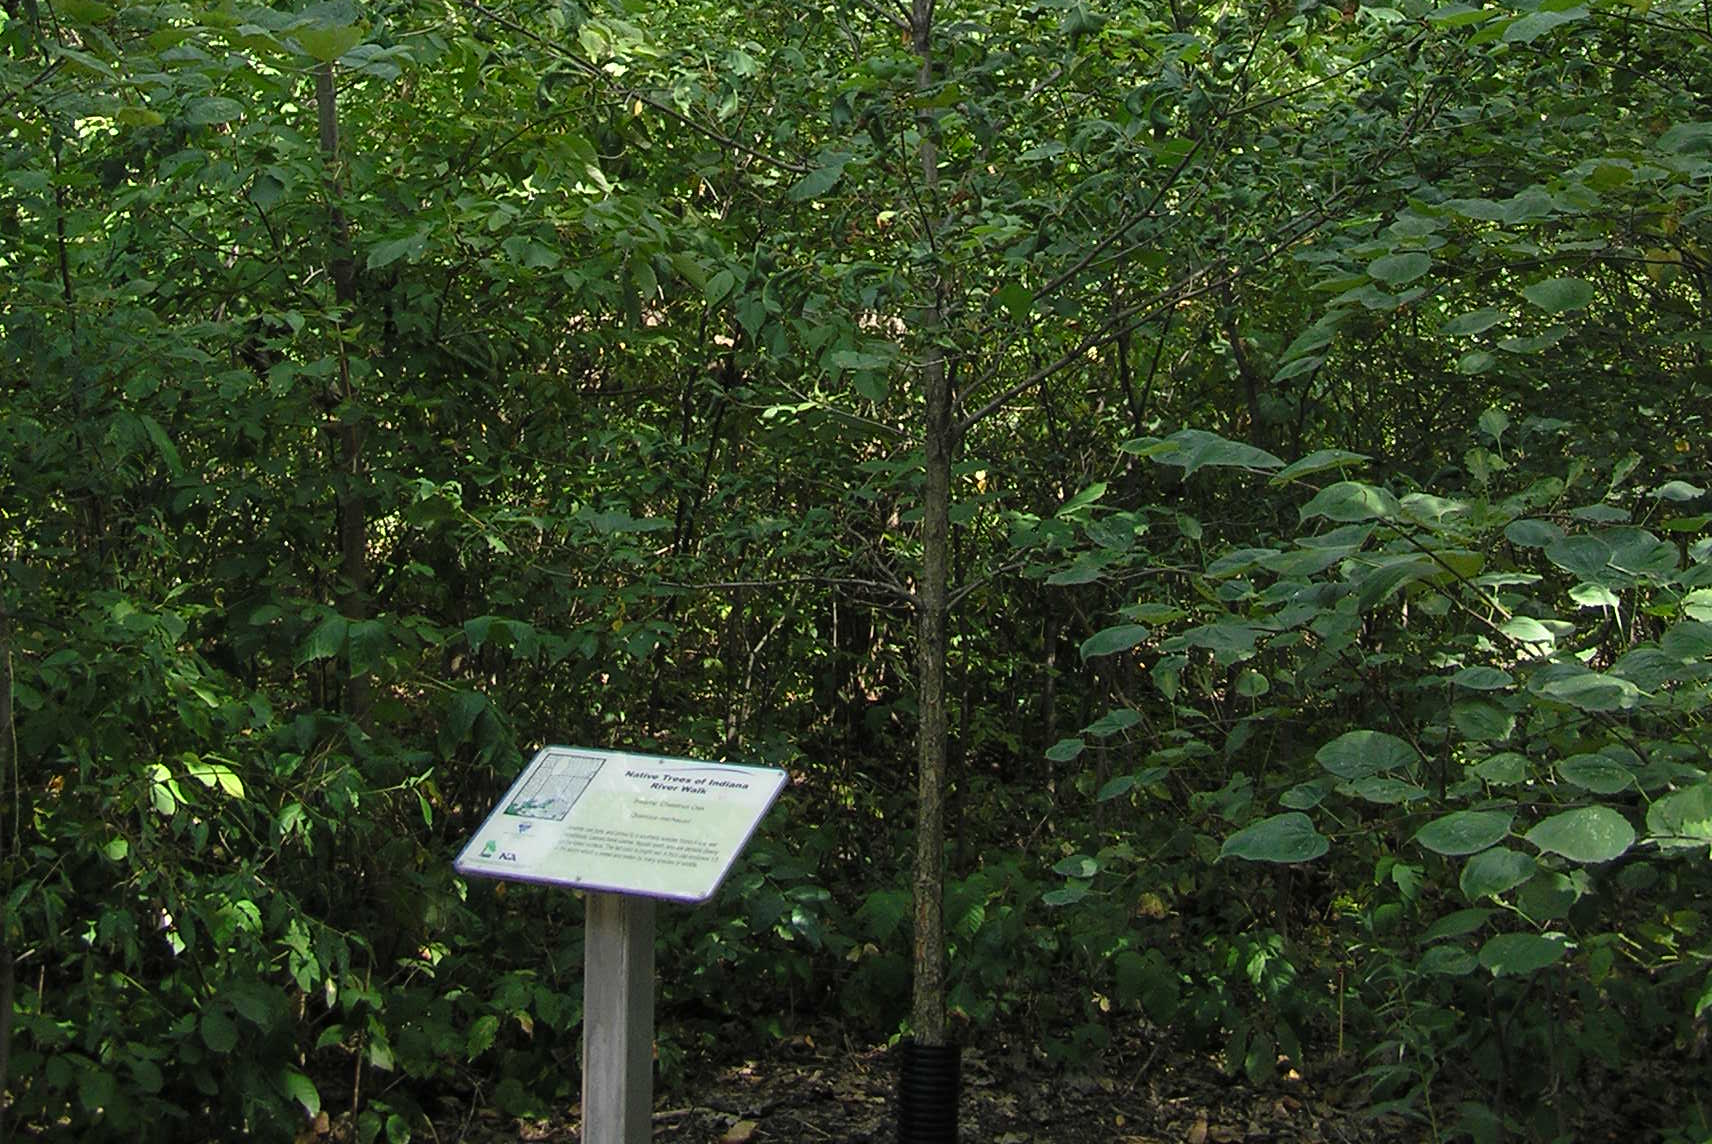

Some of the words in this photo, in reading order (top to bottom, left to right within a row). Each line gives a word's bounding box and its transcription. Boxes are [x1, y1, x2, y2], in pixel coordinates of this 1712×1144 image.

[625, 770, 659, 780] Native
[663, 774, 691, 784] Trees
[694, 778, 706, 786] of
[708, 780, 750, 790] Indiana
[650, 782, 678, 792] River
[681, 785, 707, 795] Walk
